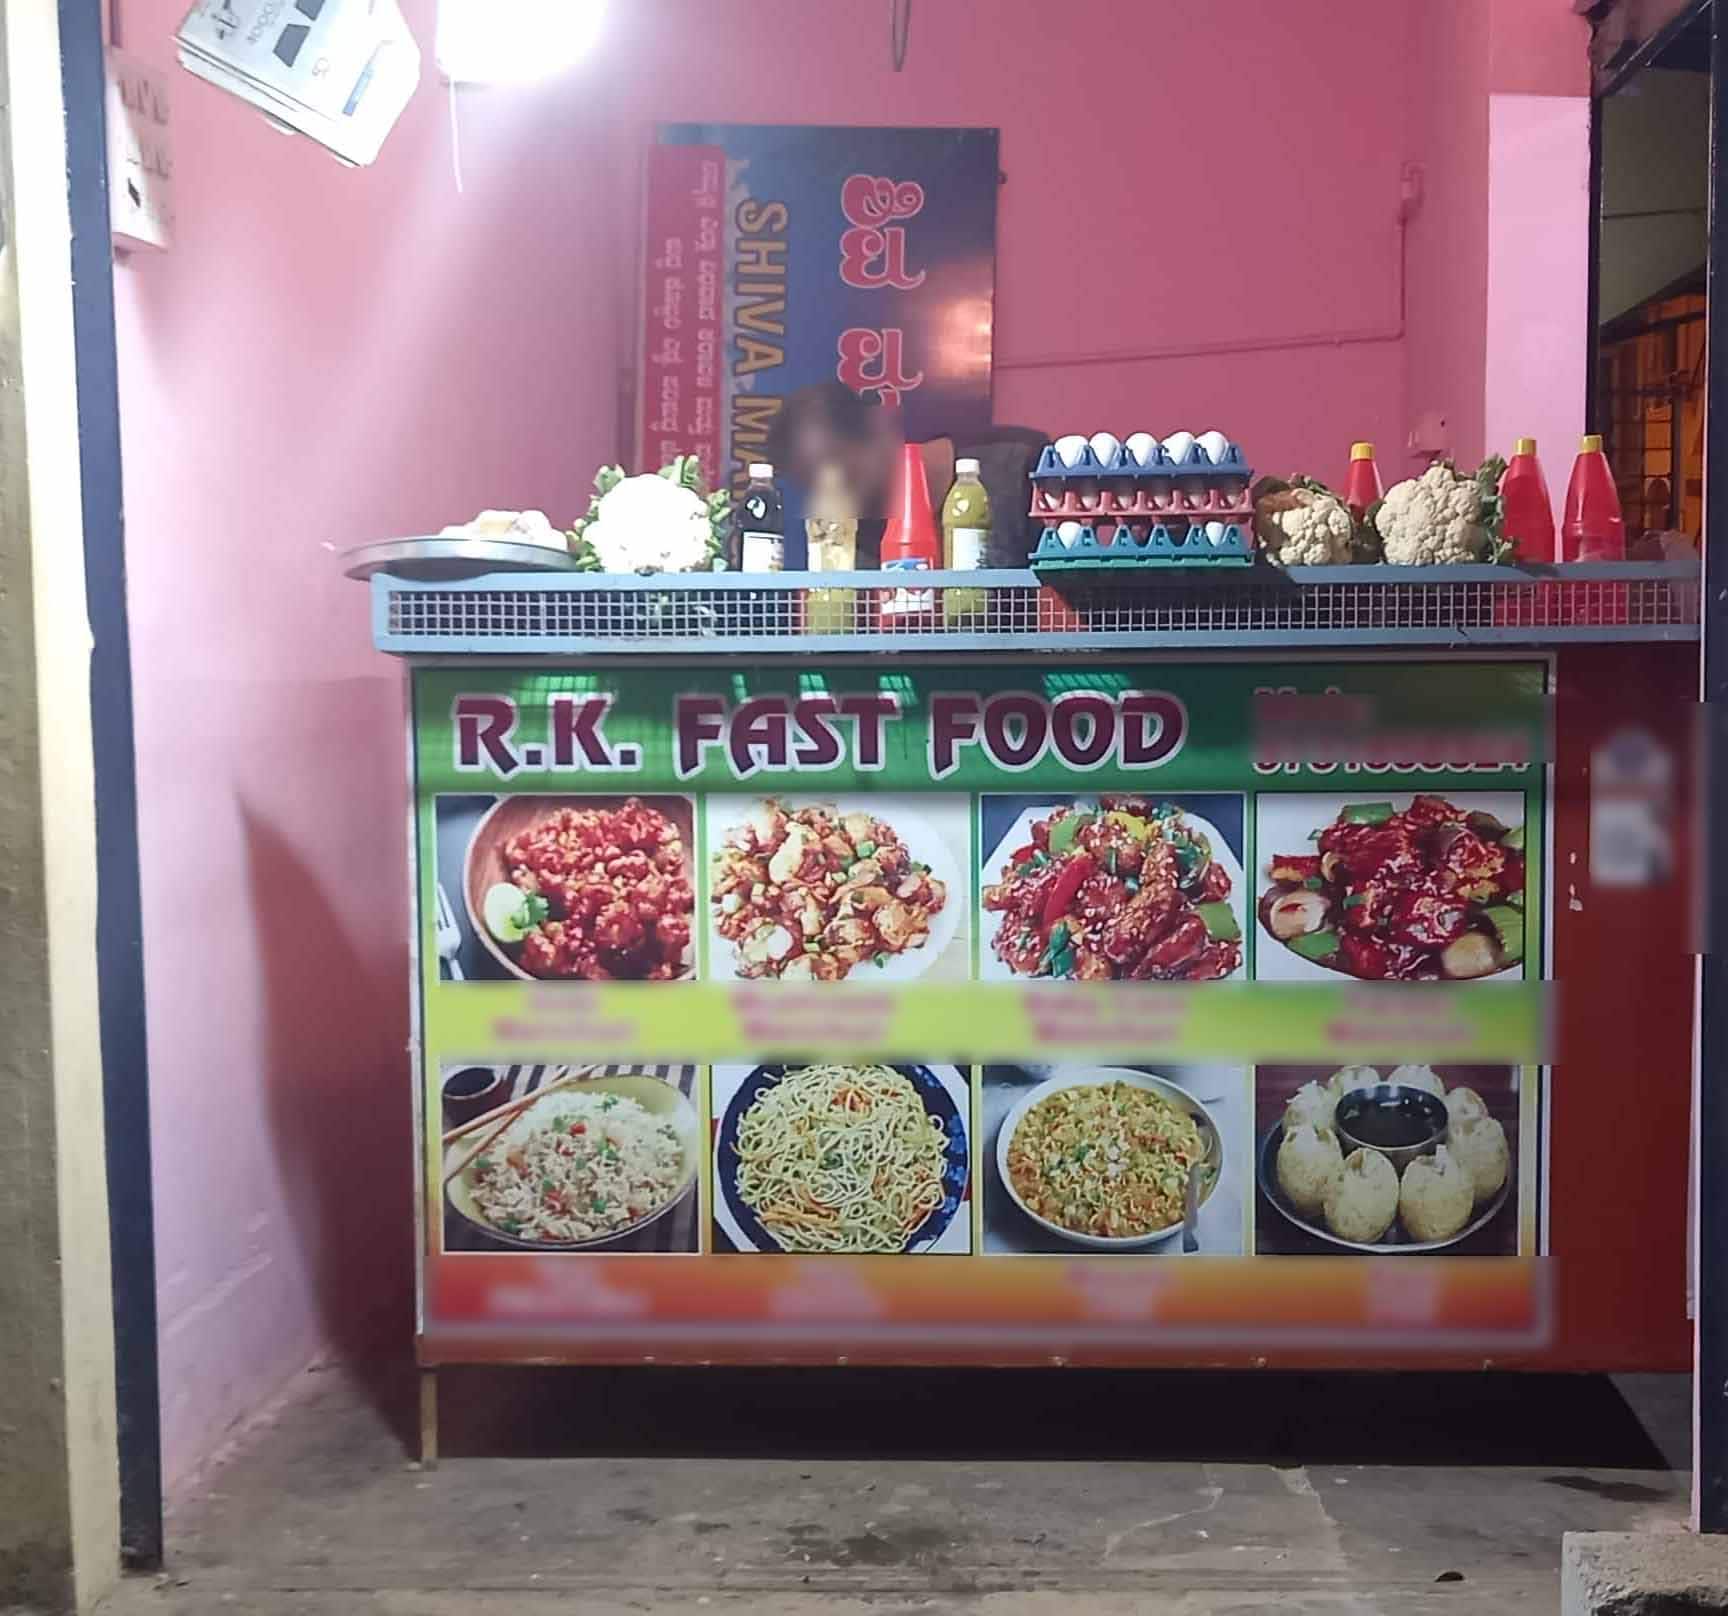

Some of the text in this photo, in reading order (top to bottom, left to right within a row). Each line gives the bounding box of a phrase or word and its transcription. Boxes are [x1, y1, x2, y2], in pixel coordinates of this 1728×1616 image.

[735, 199, 790, 376] SHIVA
[839, 173, 926, 291] ಶಿವ
[453, 693, 644, 780] R.K.
[673, 692, 899, 780] FAST
[927, 689, 1189, 780] FOOD
